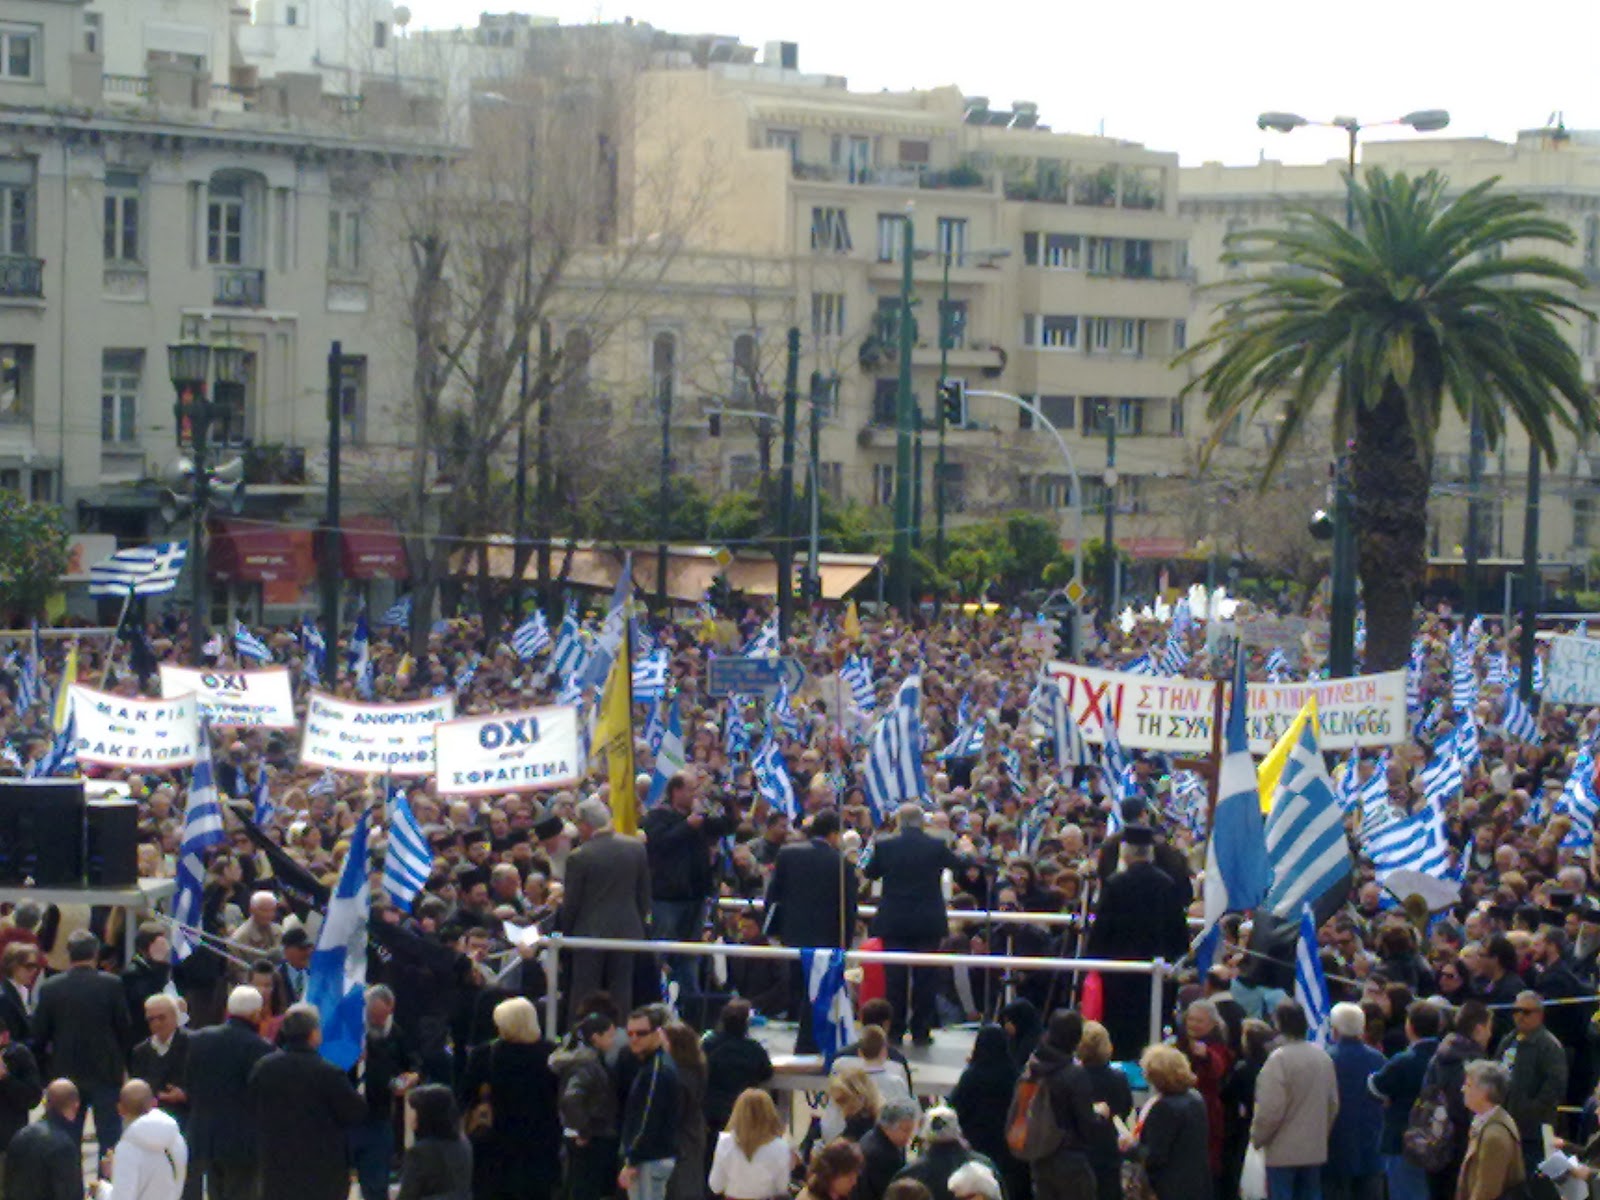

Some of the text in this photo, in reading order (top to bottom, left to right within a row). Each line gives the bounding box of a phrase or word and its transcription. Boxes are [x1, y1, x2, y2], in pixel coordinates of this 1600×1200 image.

[201, 673, 248, 691] ΟΧΙ
[1137, 685, 1199, 711] ΣΤΗΝ
[479, 716, 540, 749] ΟΧΙ
[453, 761, 569, 784] ΣΦΡΑΓΙΣΜΑ
